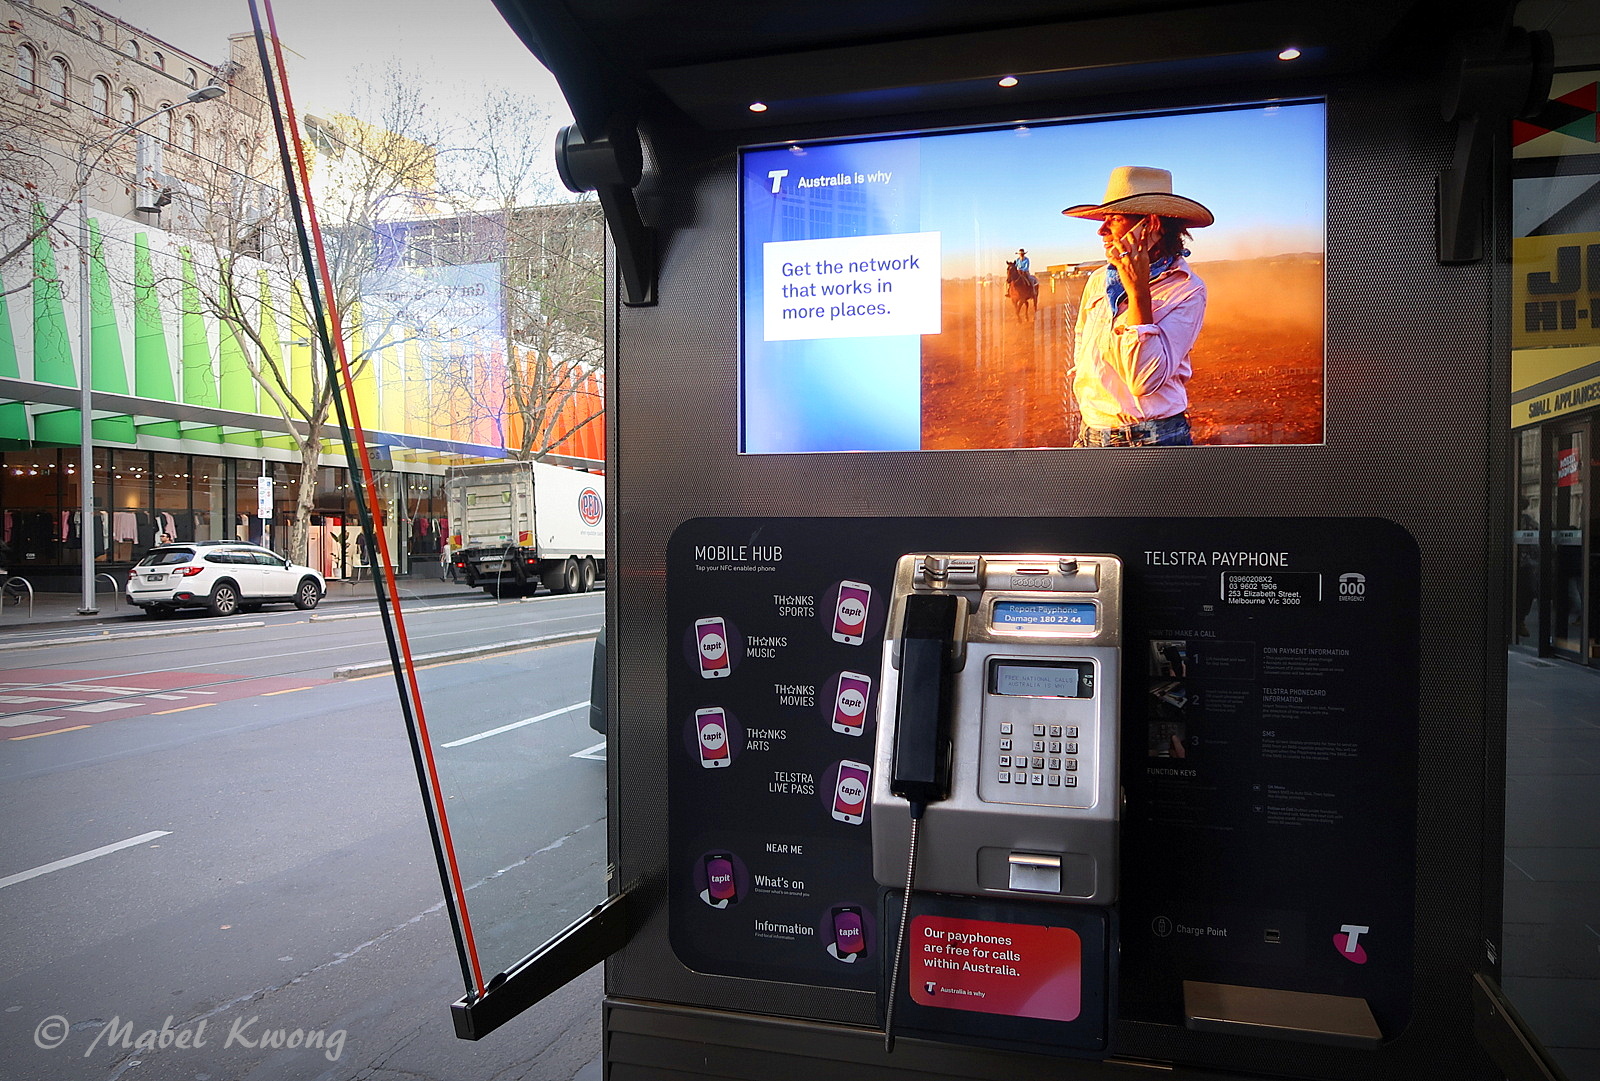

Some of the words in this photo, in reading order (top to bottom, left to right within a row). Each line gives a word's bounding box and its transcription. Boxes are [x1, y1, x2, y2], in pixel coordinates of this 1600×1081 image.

[797, 173, 851, 189] Australia
[854, 172, 865, 184] is
[867, 170, 892, 184] why
[782, 262, 811, 277] Get
[816, 260, 843, 275] the
[849, 255, 920, 273] network
[782, 283, 817, 298] that
[821, 280, 872, 296] works
[877, 278, 892, 293] in
[782, 306, 825, 319] more
[830, 302, 891, 321] places.
[1529, 397, 1552, 418] SMALL
[695, 545, 748, 561] MOBILE
[752, 546, 783, 561] HUB
[1144, 551, 1207, 566] TELSTRA
[1211, 552, 1289, 567] PAYPHONE
[1243, 590, 1276, 598] Elizabeth
[1339, 582, 1365, 595] 000
[1228, 597, 1266, 605] Melbourne
[778, 606, 815, 617] SPORTS
[841, 606, 862, 617] tapit
[1009, 605, 1036, 613] Report
[1038, 605, 1078, 614] Payphone
[1004, 614, 1038, 624] Damage
[1040, 615, 1056, 623] 180
[1070, 616, 1081, 624] 44
[702, 641, 722, 652] tapit
[1308, 648, 1350, 656] INFORMATION
[746, 648, 776, 659] MUSIC
[1193, 653, 1200, 664] 1
[1289, 688, 1327, 697] PHONECARD
[779, 696, 815, 707] MOVIES
[841, 696, 862, 708] tapit
[1262, 695, 1303, 703] INFORMATION
[702, 731, 722, 742] tapit
[746, 740, 770, 751] ARTS
[774, 771, 814, 784] TELSTRA
[1147, 767, 1179, 776] FUNCTION
[1180, 769, 1197, 777] KEYS
[768, 782, 789, 794] LIVE
[790, 783, 815, 795] PASS
[841, 785, 862, 797] tapit
[766, 842, 788, 854] NEAR
[790, 844, 803, 855] ME
[711, 873, 730, 884] tapit
[754, 874, 789, 889] What's
[792, 880, 804, 890] on
[755, 919, 814, 936] Information
[838, 926, 859, 937] tapit
[1176, 924, 1204, 936] Charge
[1206, 926, 1227, 937] Point
[924, 927, 945, 939] Our
[947, 931, 1012, 946] payphones
[924, 943, 943, 954] are
[946, 944, 970, 957] free
[972, 947, 989, 959] for
[992, 949, 1021, 962] calls
[924, 957, 960, 970] within
[962, 961, 1021, 977] Australia.
[940, 986, 967, 996] Australia
[973, 990, 986, 998] why
